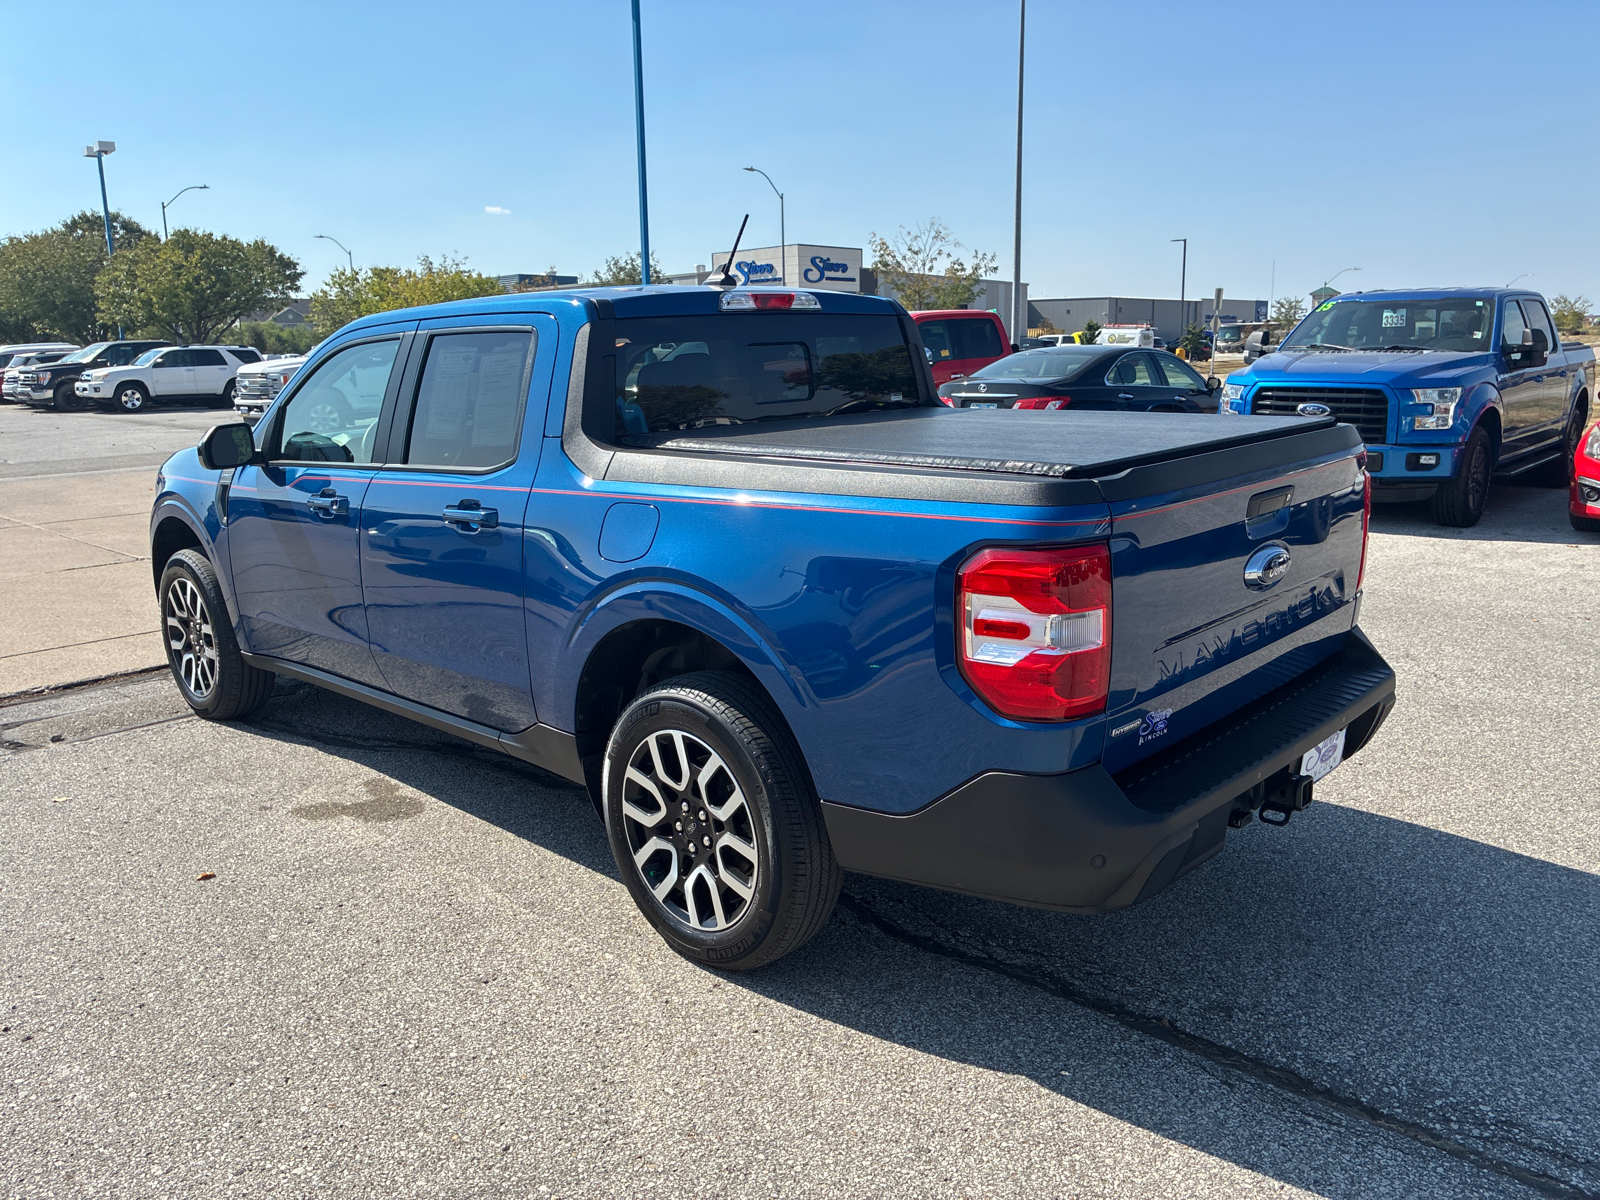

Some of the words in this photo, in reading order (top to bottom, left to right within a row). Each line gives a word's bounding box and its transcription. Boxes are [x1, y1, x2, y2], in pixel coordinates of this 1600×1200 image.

[732, 260, 775, 286] Stivers
[803, 256, 848, 283] Stivers
[1384, 315, 1405, 326] 3335
[1156, 585, 1331, 685] MAVERICK
[617, 703, 659, 740] MICHELIN
[1138, 728, 1168, 746] LINCOLN
[707, 932, 758, 960] MICHELIN
